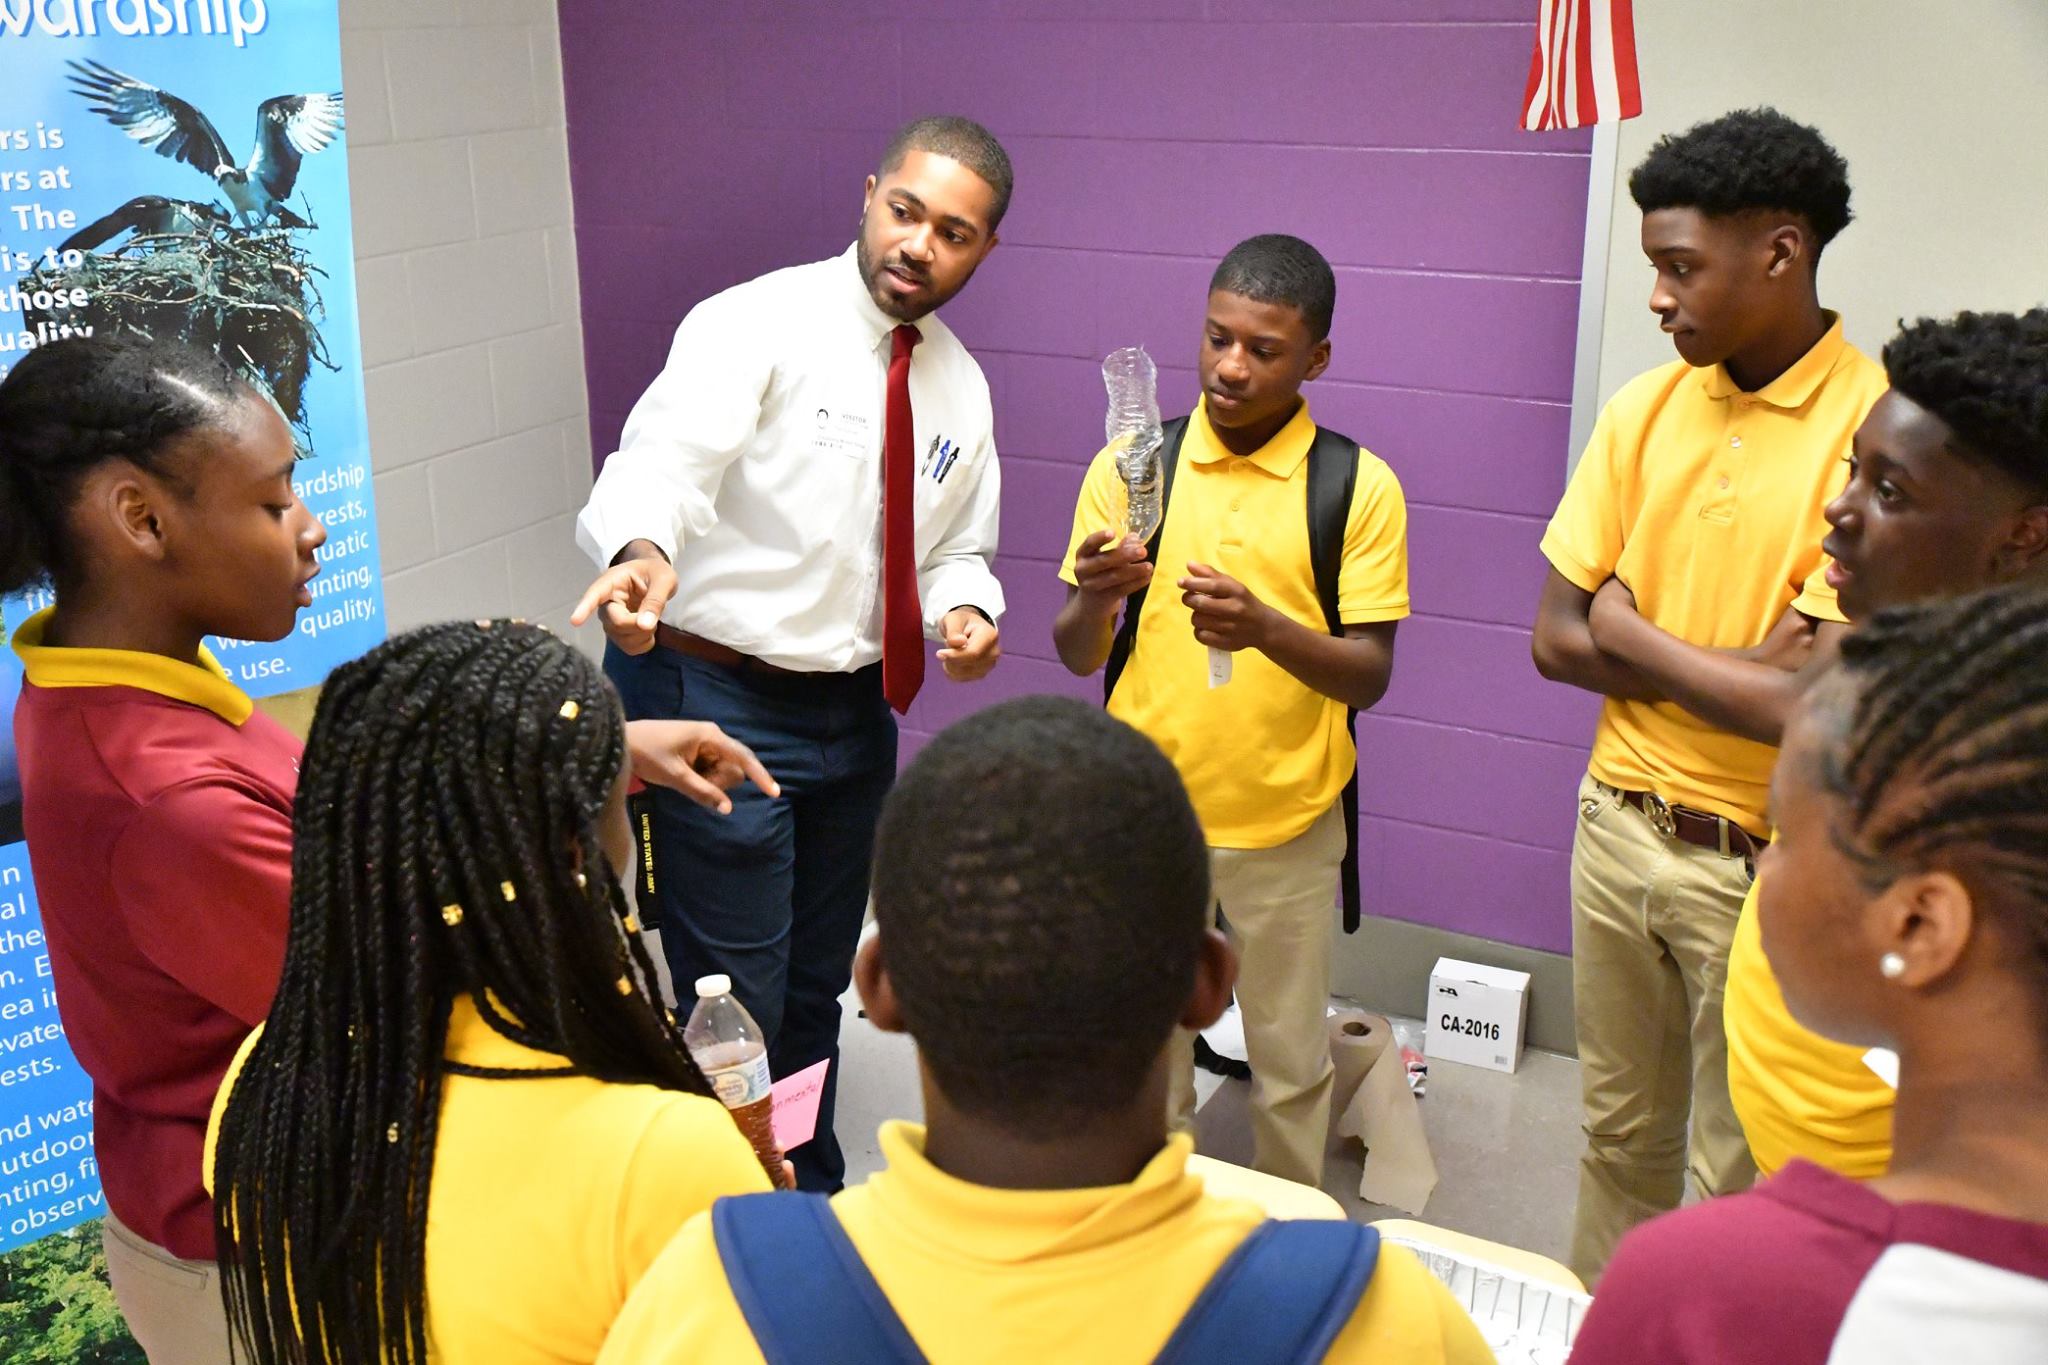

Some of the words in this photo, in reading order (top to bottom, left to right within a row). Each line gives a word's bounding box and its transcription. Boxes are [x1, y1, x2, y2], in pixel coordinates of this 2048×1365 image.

[36, 121, 64, 149] is
[39, 165, 71, 189] at
[11, 203, 77, 231] The
[1, 245, 32, 272] is
[44, 246, 83, 269] to
[0, 285, 89, 312] those
[300, 597, 376, 638] quality,
[241, 657, 292, 680] use.
[641, 813, 651, 842] UNITED
[643, 842, 653, 872] STATES
[646, 872, 656, 895] ARMY
[1441, 1013, 1500, 1041] CA-2016
